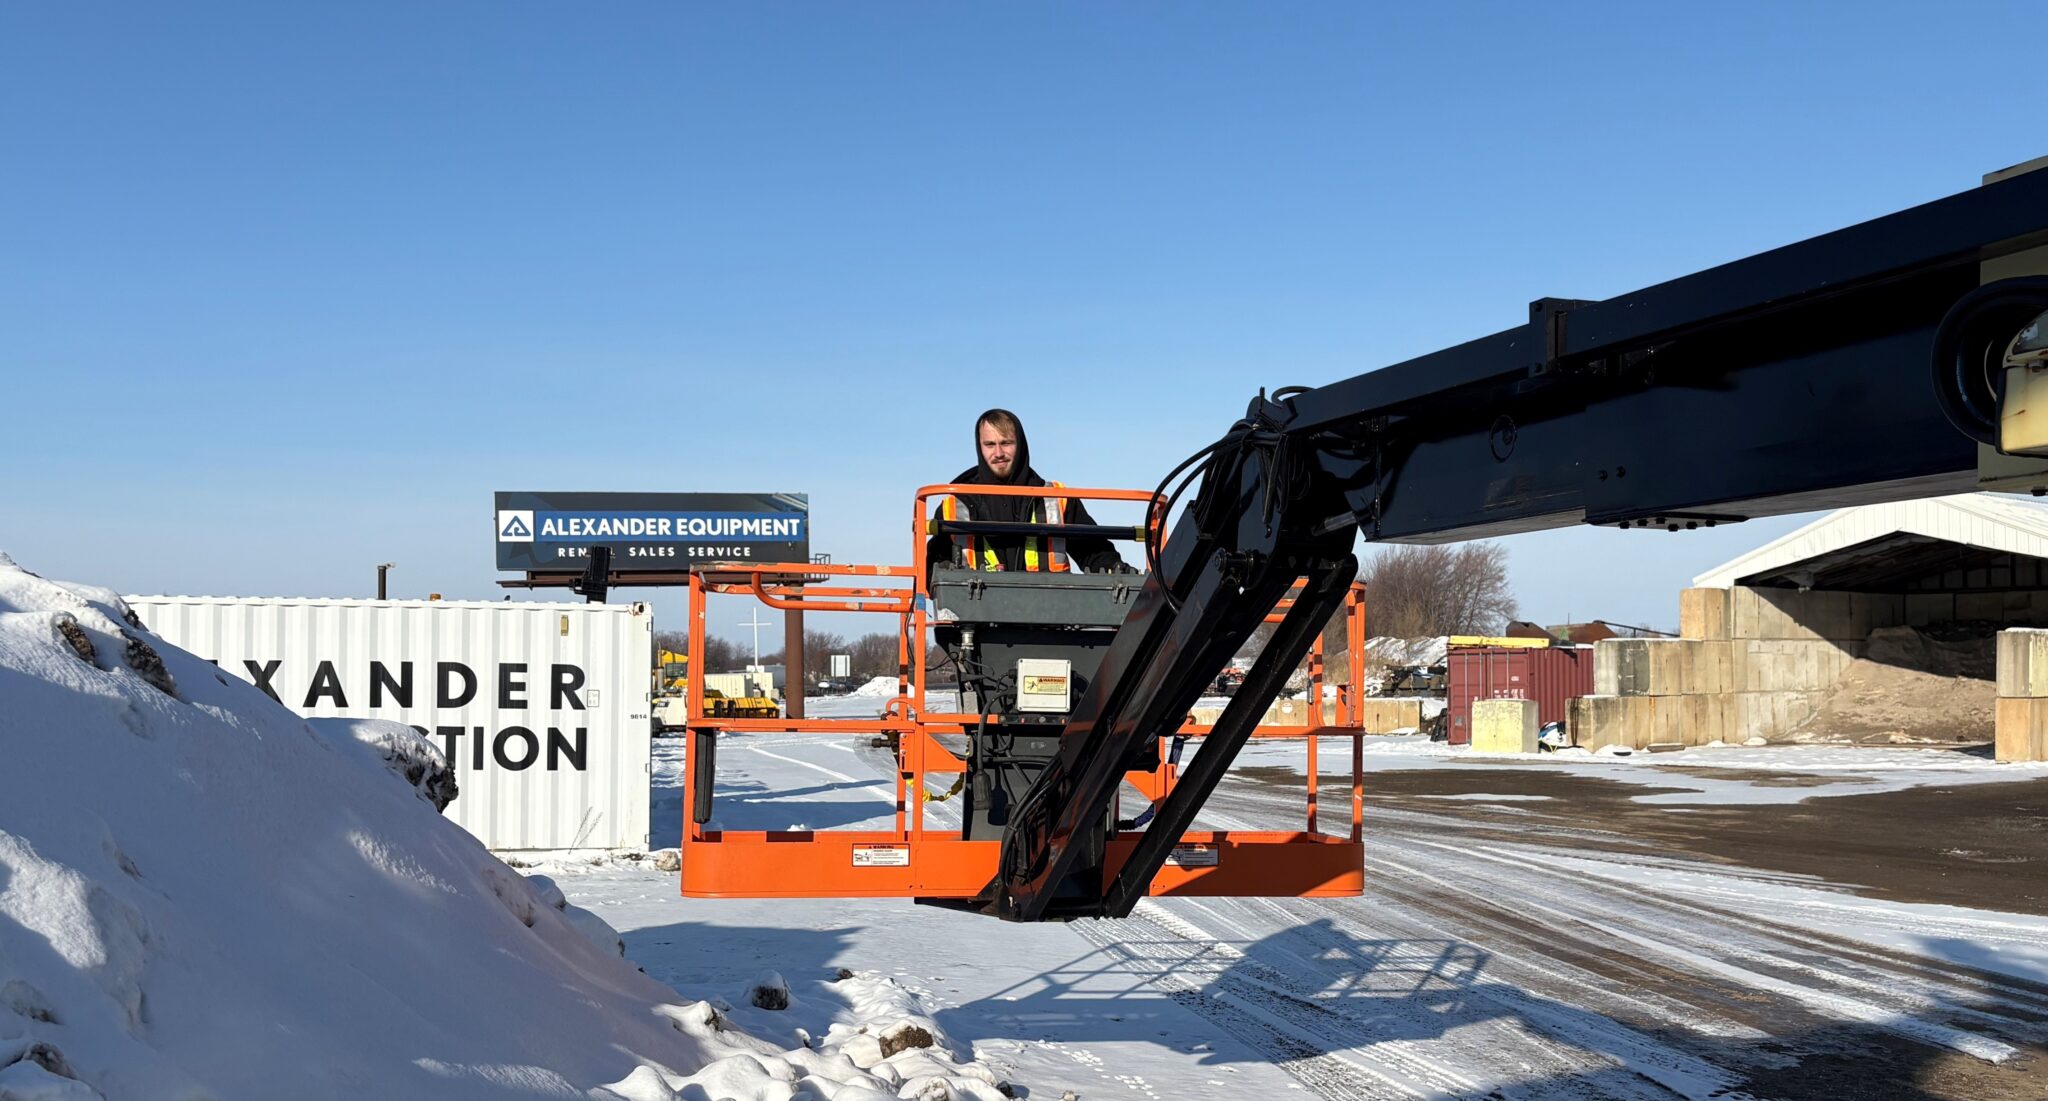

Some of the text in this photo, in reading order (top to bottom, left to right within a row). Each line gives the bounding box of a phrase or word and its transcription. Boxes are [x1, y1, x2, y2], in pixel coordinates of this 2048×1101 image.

[541, 518, 800, 536] ALEXANDER EQUIPMENT
[629, 546, 675, 557] SALES
[688, 547, 750, 557] SERVICE
[205, 659, 587, 710] XANDER
[410, 724, 588, 772] TION
